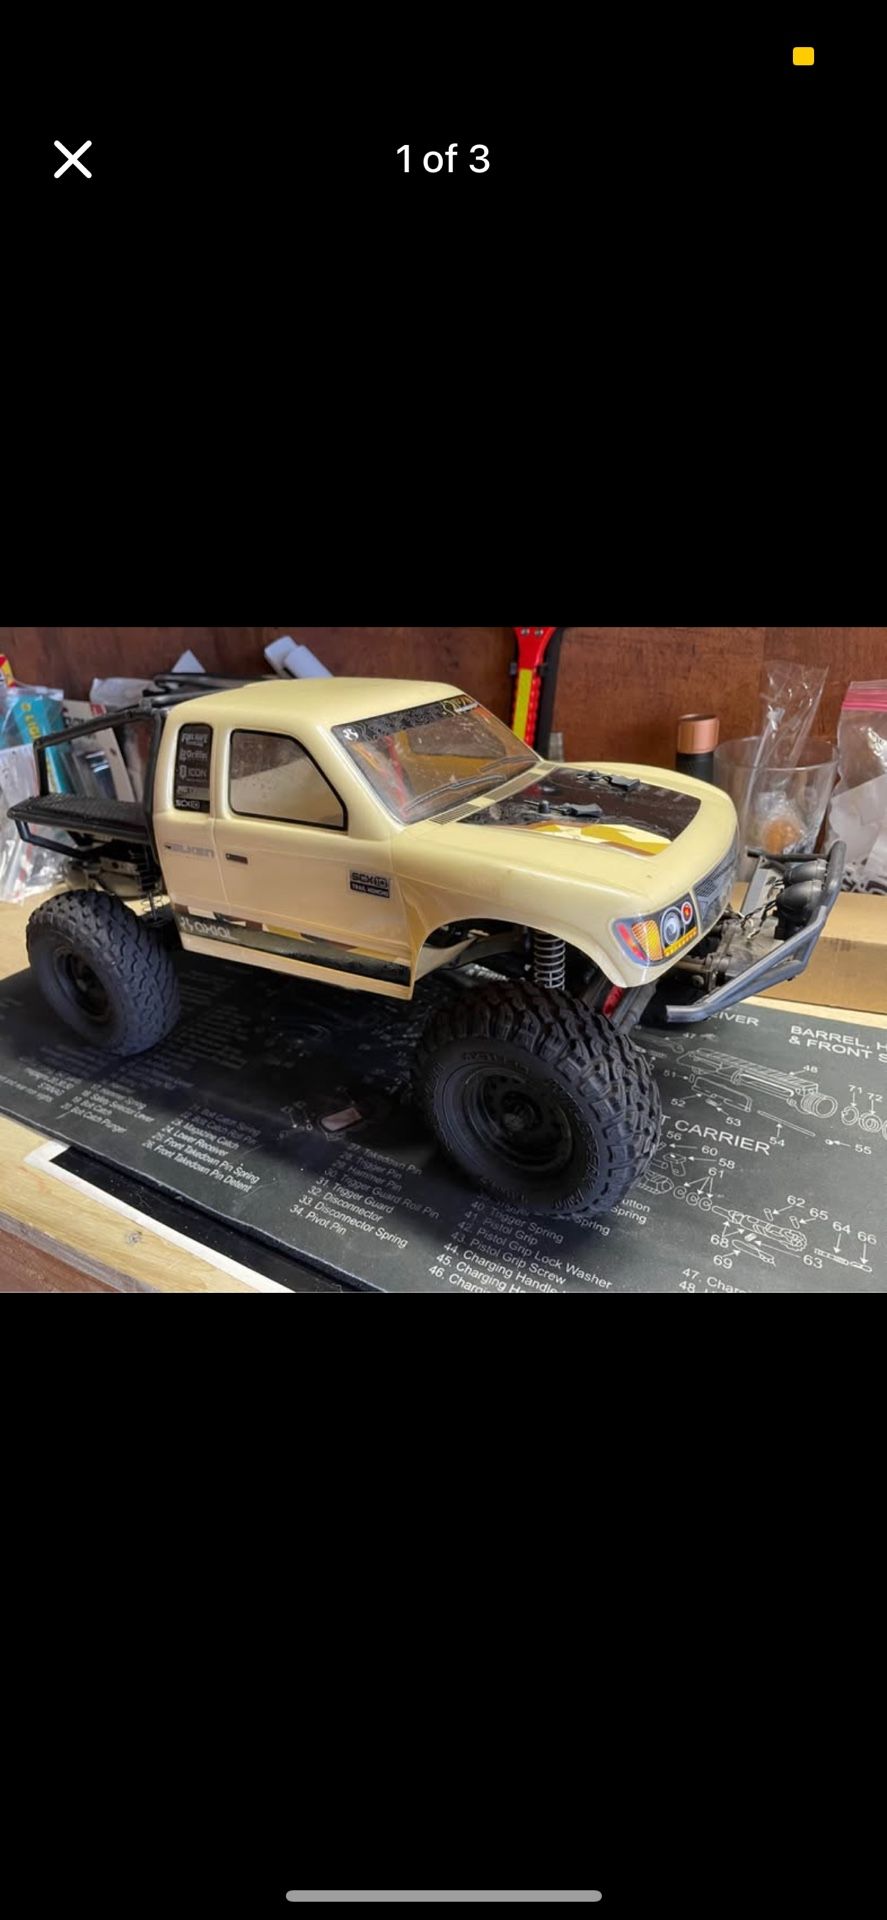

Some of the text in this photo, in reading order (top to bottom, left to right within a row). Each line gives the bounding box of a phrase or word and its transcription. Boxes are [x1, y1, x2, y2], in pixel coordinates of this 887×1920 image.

[789, 1035, 801, 1046] &
[806, 1039, 873, 1059] FRONT
[803, 1065, 818, 1074] 48
[848, 1084, 863, 1095] 71
[866, 1092, 884, 1103] 72
[670, 1098, 686, 1108] 52
[725, 1116, 741, 1127] 53
[183, 1122, 218, 1143] Magazine
[216, 1135, 241, 1150] Catch
[666, 1130, 682, 1141] 56
[674, 1119, 771, 1156] CARRIER
[769, 1136, 785, 1148] 54
[173, 1130, 197, 1144] Lower
[194, 1138, 229, 1158] Receiver
[701, 1145, 719, 1157] 60
[854, 1144, 872, 1155] 55
[153, 1144, 176, 1159] Front
[174, 1152, 212, 1176] Takedown
[209, 1168, 225, 1182] Pin
[222, 1175, 253, 1193] Detent
[163, 1136, 186, 1150] Front
[183, 1145, 221, 1167] Takedown
[218, 1160, 235, 1173] Pin
[233, 1165, 261, 1185] Spring
[718, 1157, 736, 1170] 58
[385, 1168, 403, 1181] Pin
[406, 1164, 423, 1176] Pin
[708, 1166, 725, 1180] 61
[386, 1179, 403, 1193] Pin
[316, 1176, 396, 1214] 31. Trigger Guard
[340, 1173, 372, 1193] Trigger
[371, 1186, 404, 1205] Guard
[421, 1206, 441, 1220] Pin
[787, 1195, 806, 1209] 62
[307, 1185, 384, 1223] 32. Disconnector
[621, 1198, 652, 1214] utton
[289, 1204, 348, 1236] 34. Pivot Pin
[298, 1194, 409, 1249] 33. Disconnector Spring
[610, 1204, 648, 1226] Spring
[809, 1207, 829, 1221] 65
[482, 1217, 513, 1235] Pistol
[514, 1229, 539, 1246] Grip
[489, 1206, 527, 1228] Trigger
[528, 1222, 565, 1245] Spring
[573, 1215, 612, 1237] Spring
[832, 1221, 852, 1235] 64
[710, 1234, 729, 1249] 68
[857, 1231, 877, 1245] 66
[443, 1242, 460, 1256] 44.
[462, 1249, 514, 1280] Charging
[450, 1231, 567, 1286] 43. Pistol Grip Screw
[457, 1220, 613, 1291] 42. Pistol Grip Lock Washer
[713, 1254, 733, 1270] 69
[803, 1254, 823, 1269] 63
[429, 1265, 446, 1280] 46.
[435, 1253, 453, 1268] 45.
[456, 1261, 508, 1292] Charging
[682, 1267, 703, 1283] 47.
